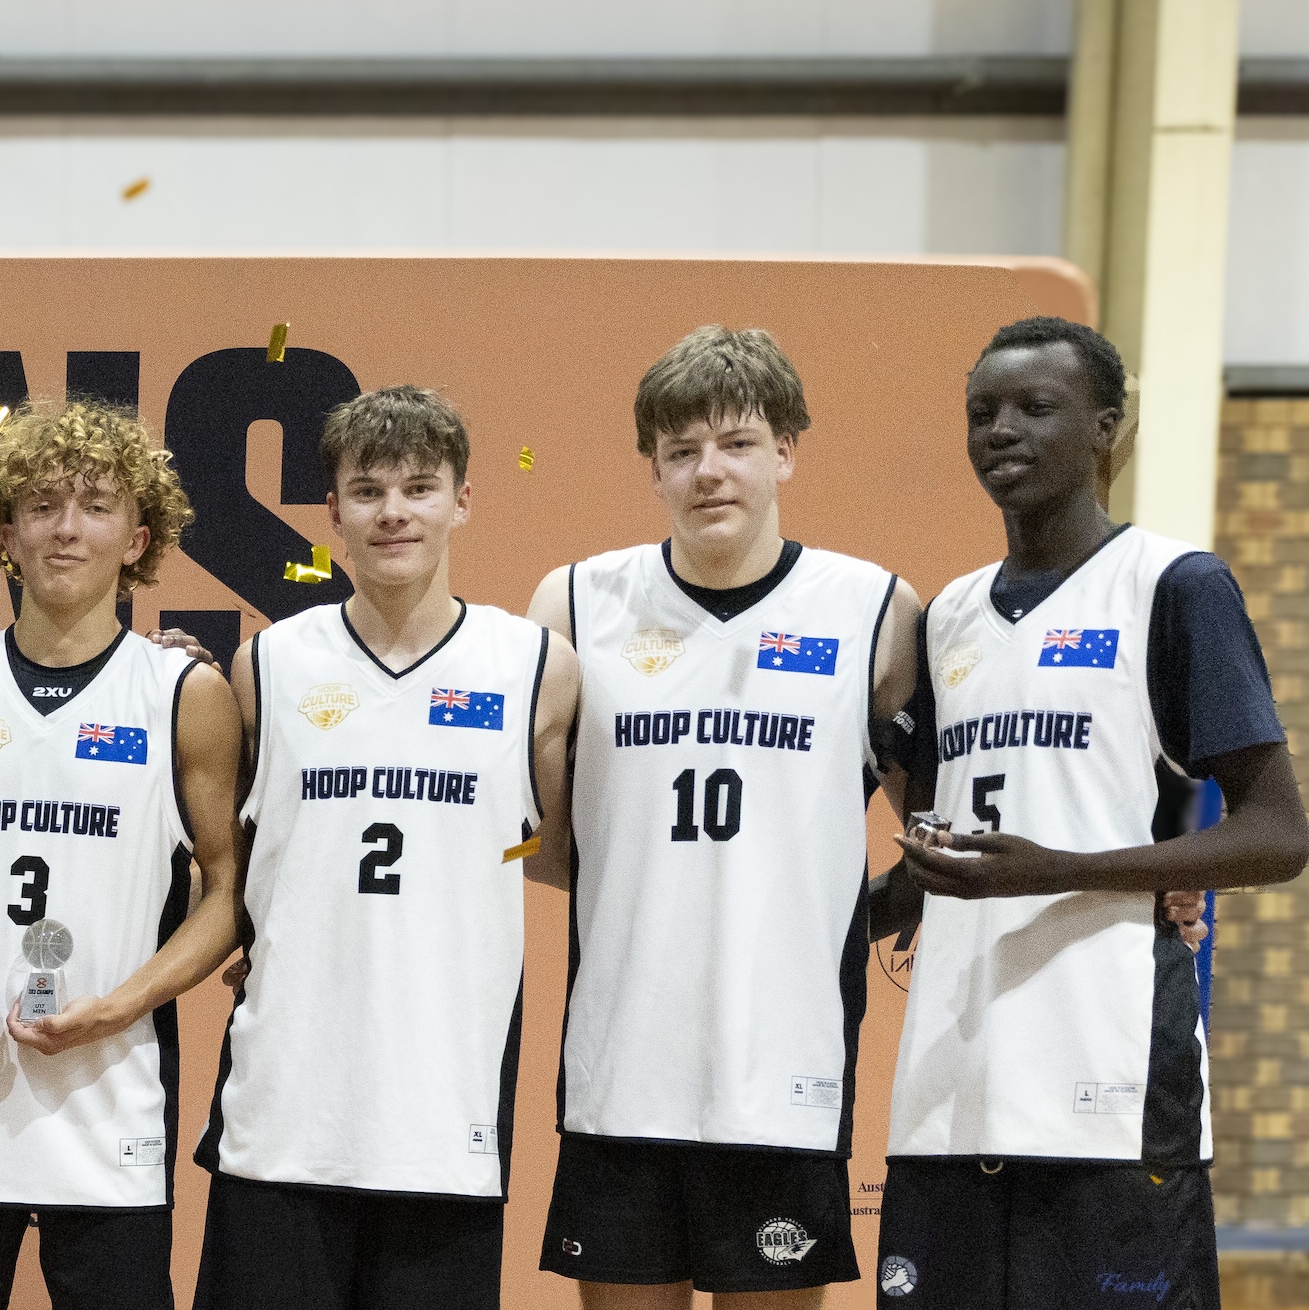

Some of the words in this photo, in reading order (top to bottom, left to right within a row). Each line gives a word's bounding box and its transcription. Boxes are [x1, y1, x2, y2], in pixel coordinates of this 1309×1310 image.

[32, 687, 72, 698] 2XU
[302, 693, 355, 709] CULTURE
[615, 710, 690, 748] HOOP
[696, 708, 814, 752] CULTURE
[938, 717, 980, 764] OOP
[980, 710, 1092, 751] CULTURE
[301, 766, 367, 802] HOOP
[372, 766, 478, 807] CULTURE
[670, 767, 744, 843] 10
[971, 773, 1005, 835] 5
[21, 800, 121, 839] CULTURE
[358, 822, 403, 896] 2
[7, 855, 50, 927] 3
[756, 1229, 808, 1248] EAGLES
